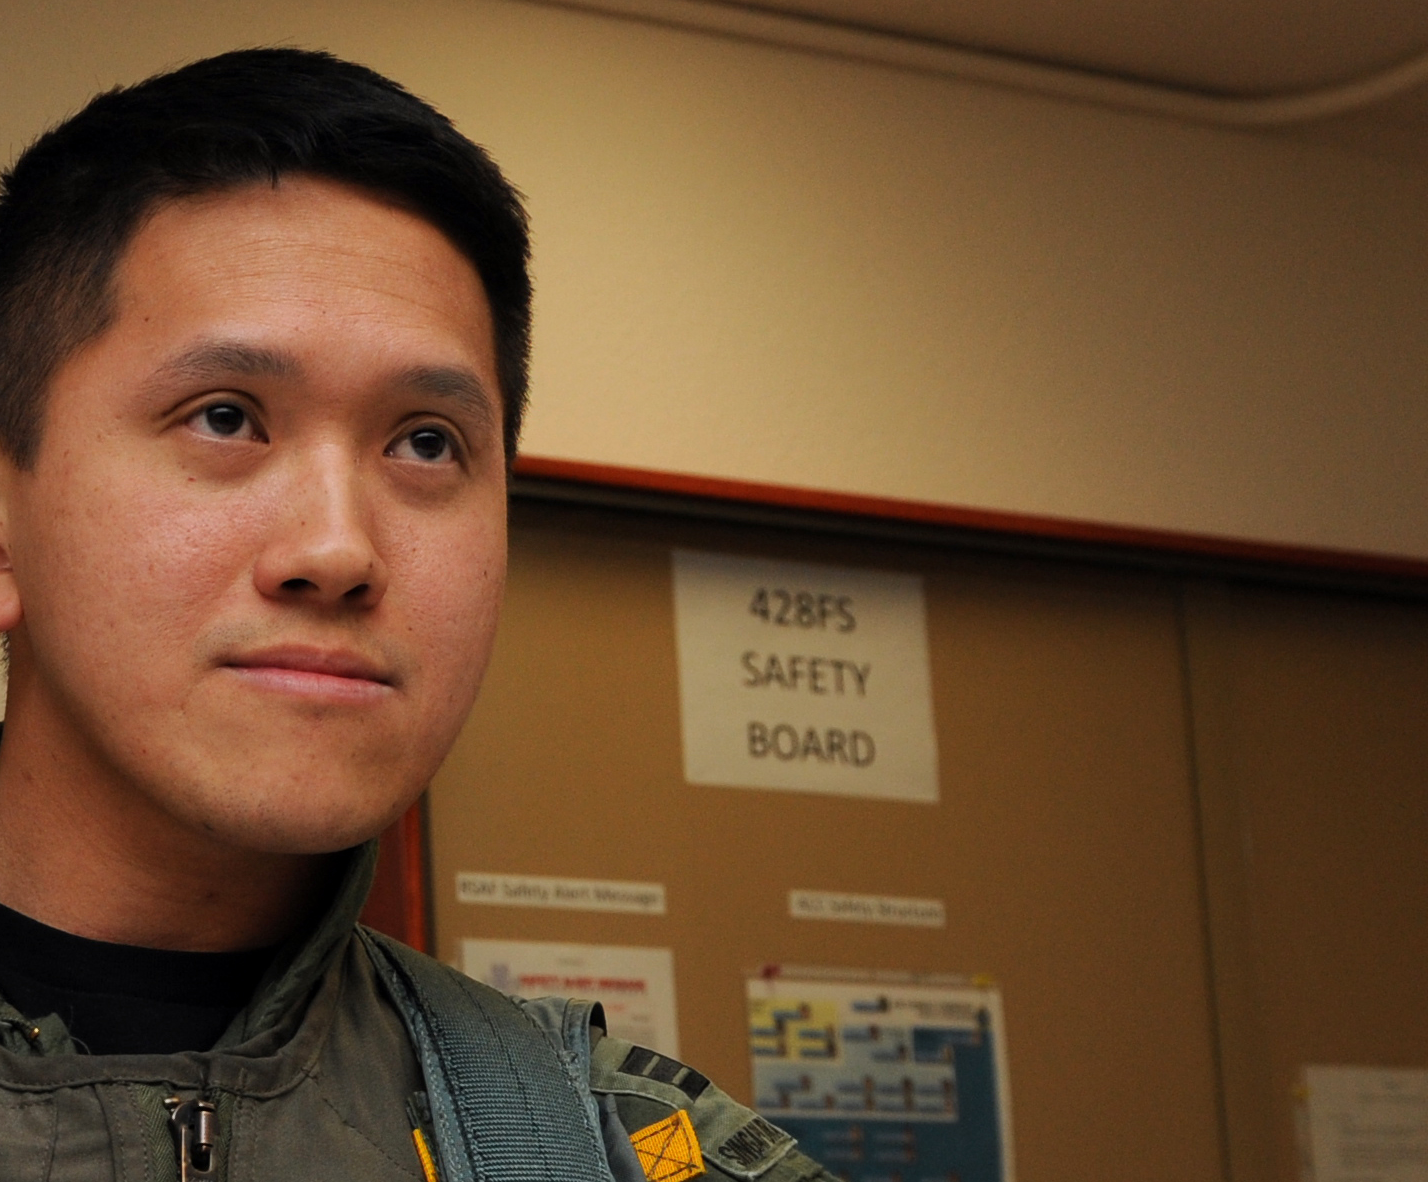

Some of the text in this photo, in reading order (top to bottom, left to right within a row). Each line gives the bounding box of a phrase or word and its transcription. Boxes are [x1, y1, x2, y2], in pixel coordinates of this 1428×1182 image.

[748, 587, 858, 634] 428FS
[740, 650, 872, 698] SAFETY
[747, 721, 877, 768] BOARD
